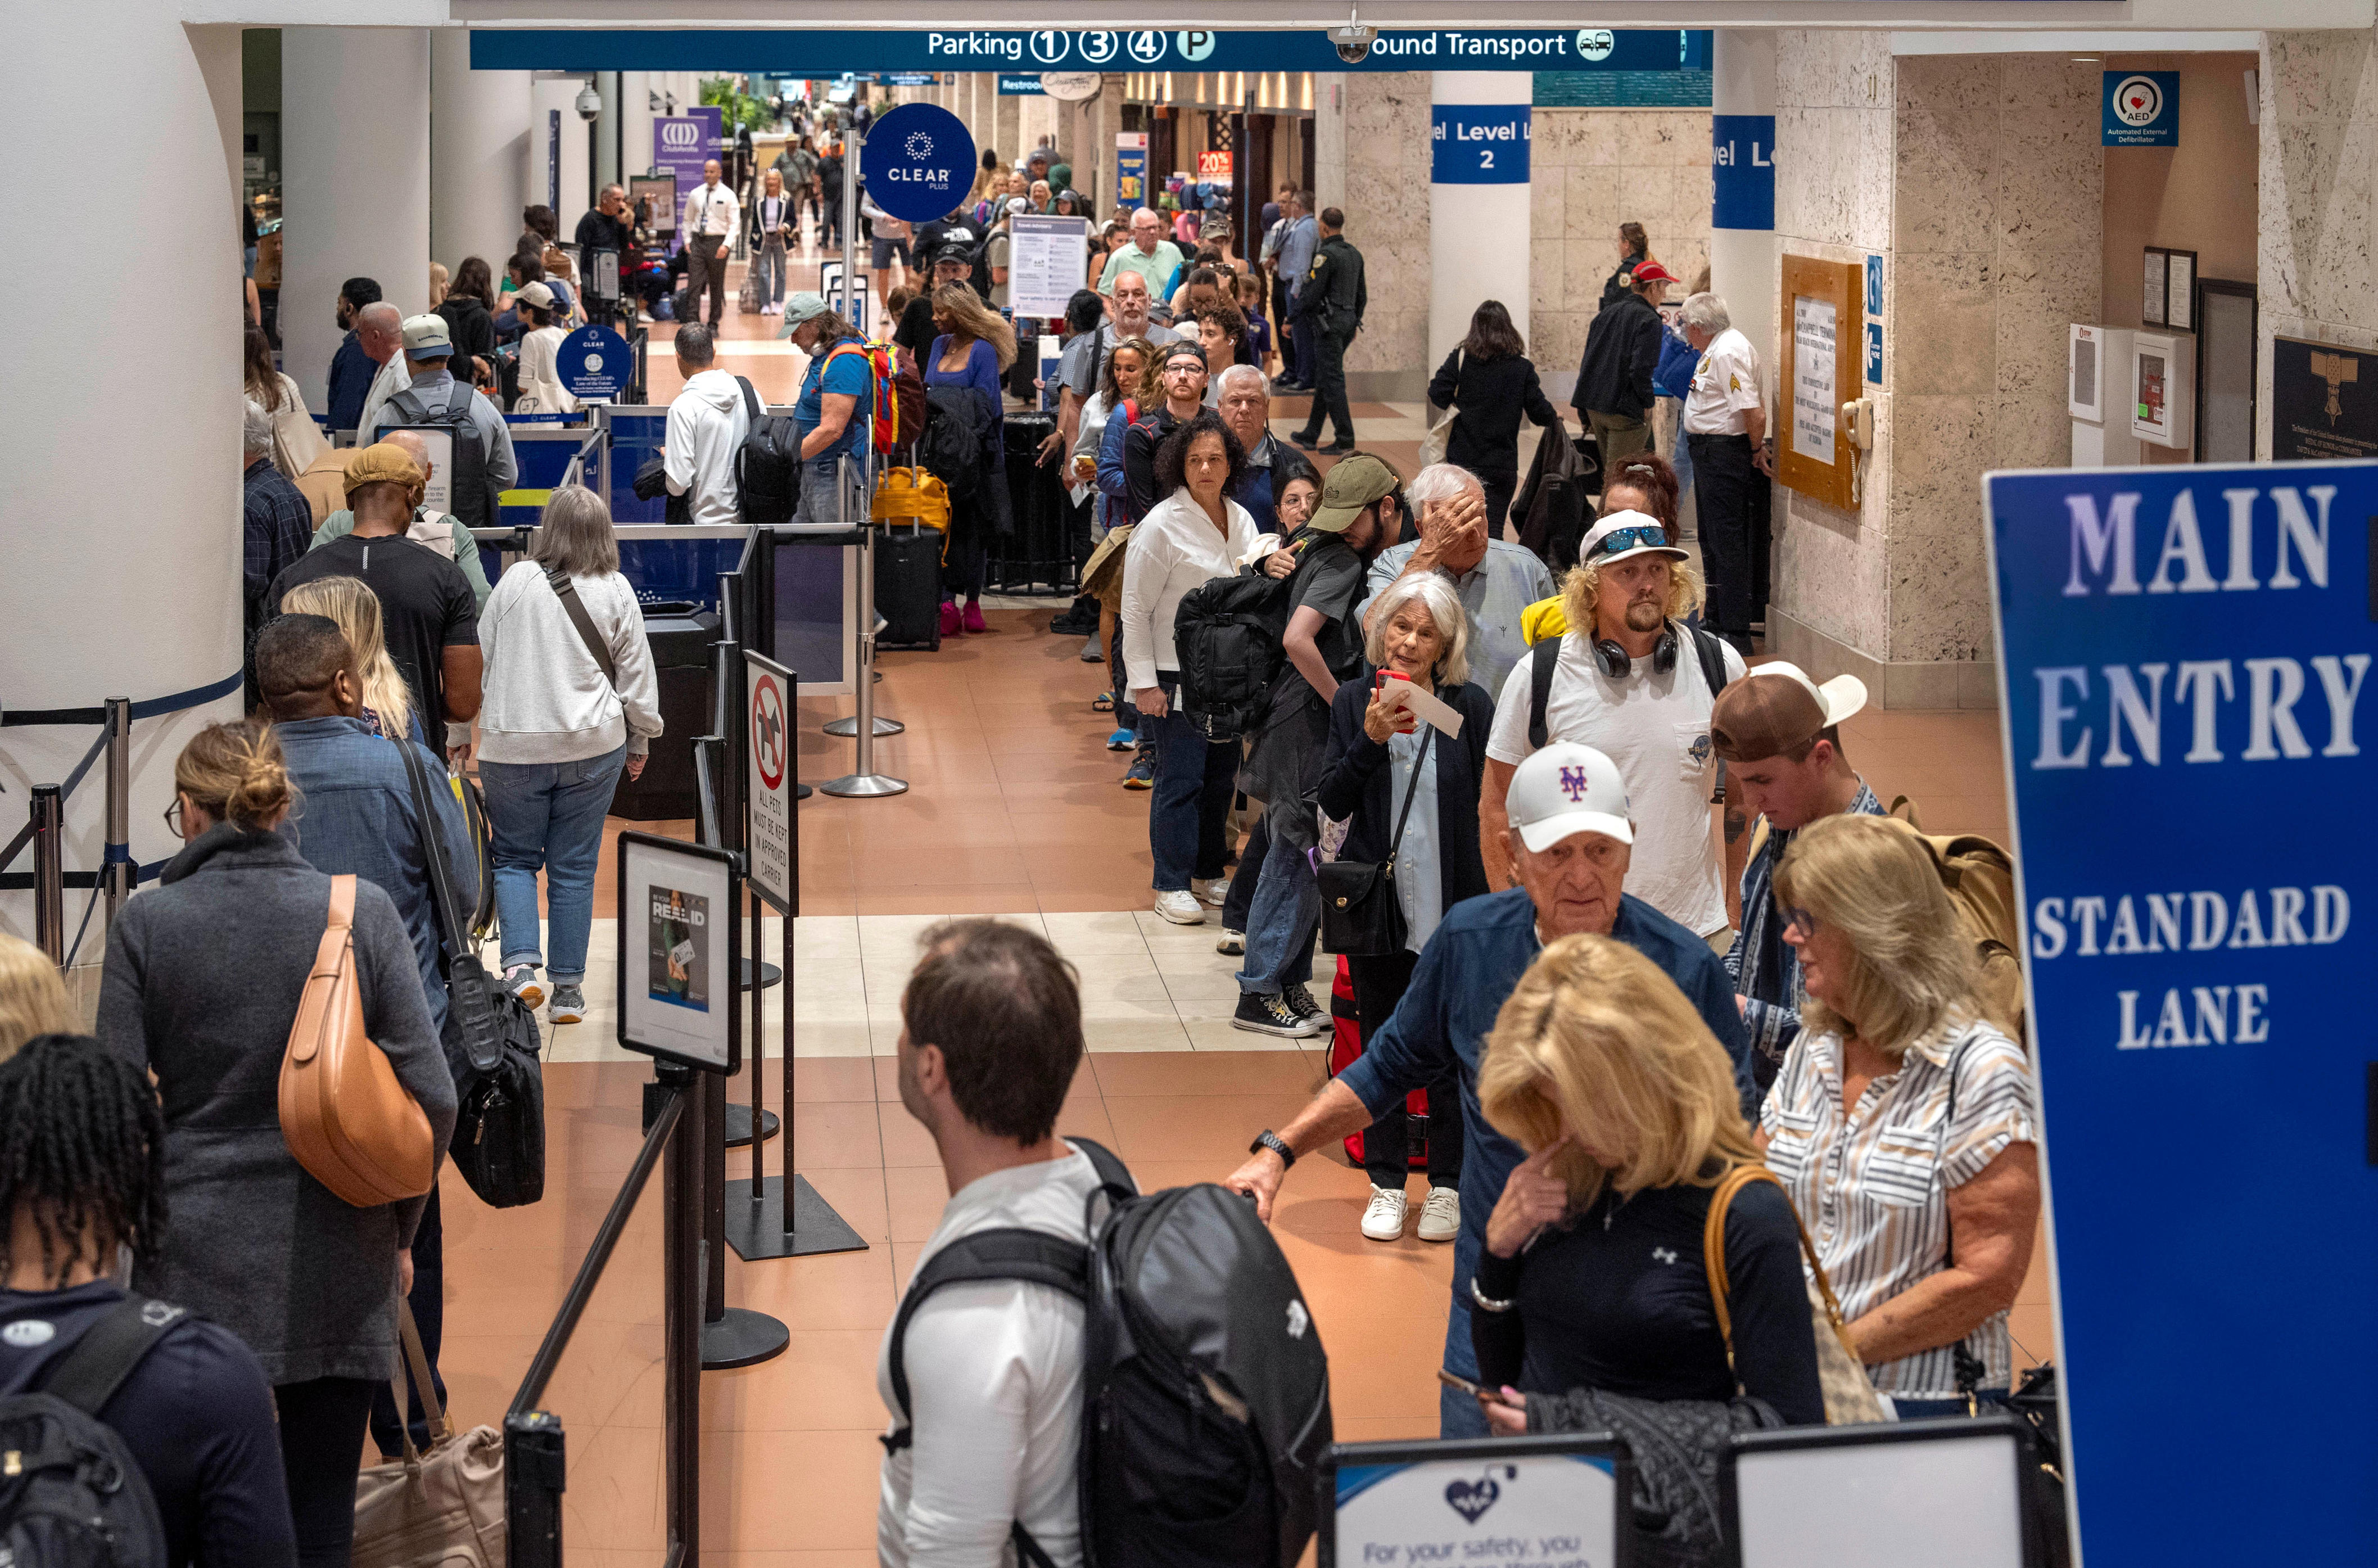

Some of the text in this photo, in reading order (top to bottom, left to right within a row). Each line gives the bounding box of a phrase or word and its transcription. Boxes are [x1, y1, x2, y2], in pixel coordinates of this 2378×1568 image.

[929, 31, 1022, 60] Parking
[1445, 32, 1567, 60] Transport
[1002, 79, 1043, 90] Restroo
[1457, 121, 1516, 141] Level
[1200, 153, 1229, 172] 20%
[1480, 150, 1495, 168] 2
[888, 168, 950, 182] CLEAR
[1870, 350, 1880, 360] PHONE
[2062, 484, 2339, 597] MAIN
[2031, 653, 2372, 771] ENTRY
[759, 789, 781, 816] ALL PETS
[754, 809, 787, 844] MUST BE KEPT
[755, 833, 786, 867] IN APPROVED
[761, 861, 781, 888] CARRIER
[653, 901, 705, 927] REAL ID
[2032, 884, 2352, 960] STANDARD
[2115, 983, 2270, 1051] LANE
[1363, 1542, 1400, 1563] For
[1407, 1542, 1456, 1565] your
[1463, 1535, 1534, 1558] safety,
[1540, 1535, 1582, 1558] you
